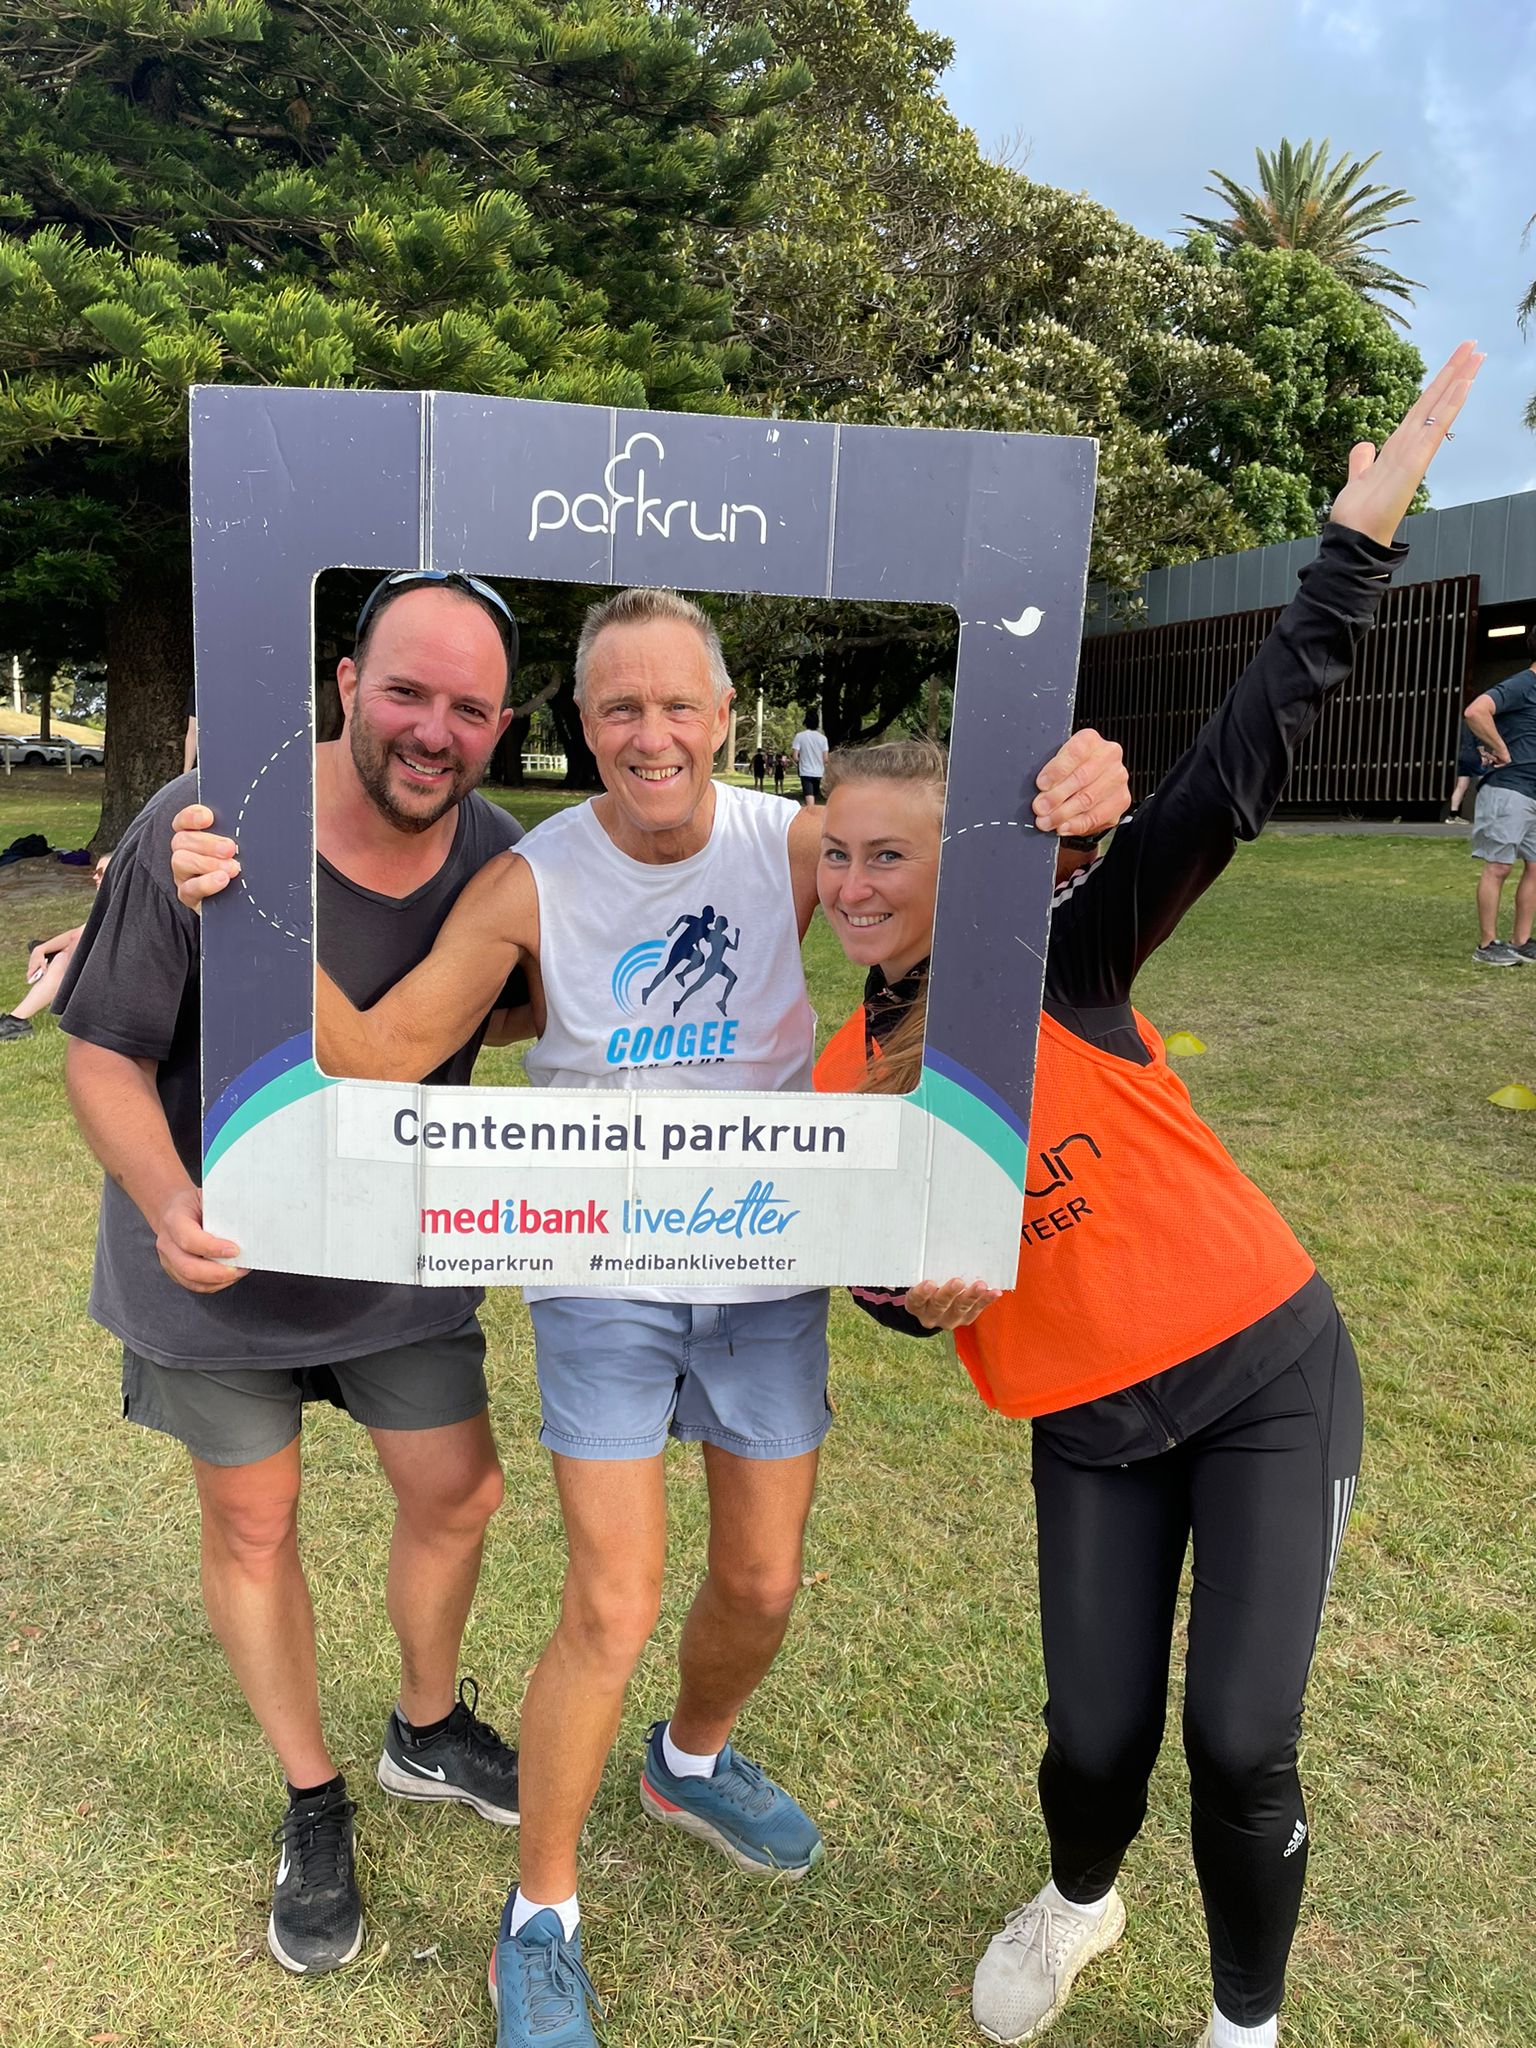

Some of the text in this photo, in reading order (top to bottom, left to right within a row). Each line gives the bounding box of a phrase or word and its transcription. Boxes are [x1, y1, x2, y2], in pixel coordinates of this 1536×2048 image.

[528, 432, 767, 544] parkrun
[606, 1019, 739, 1064] COOGEE
[393, 1108, 846, 1160] Centennial parkrun
[421, 1199, 609, 1234] medibank
[417, 1253, 797, 1274] #loveparkrun #medibanklivebetter
